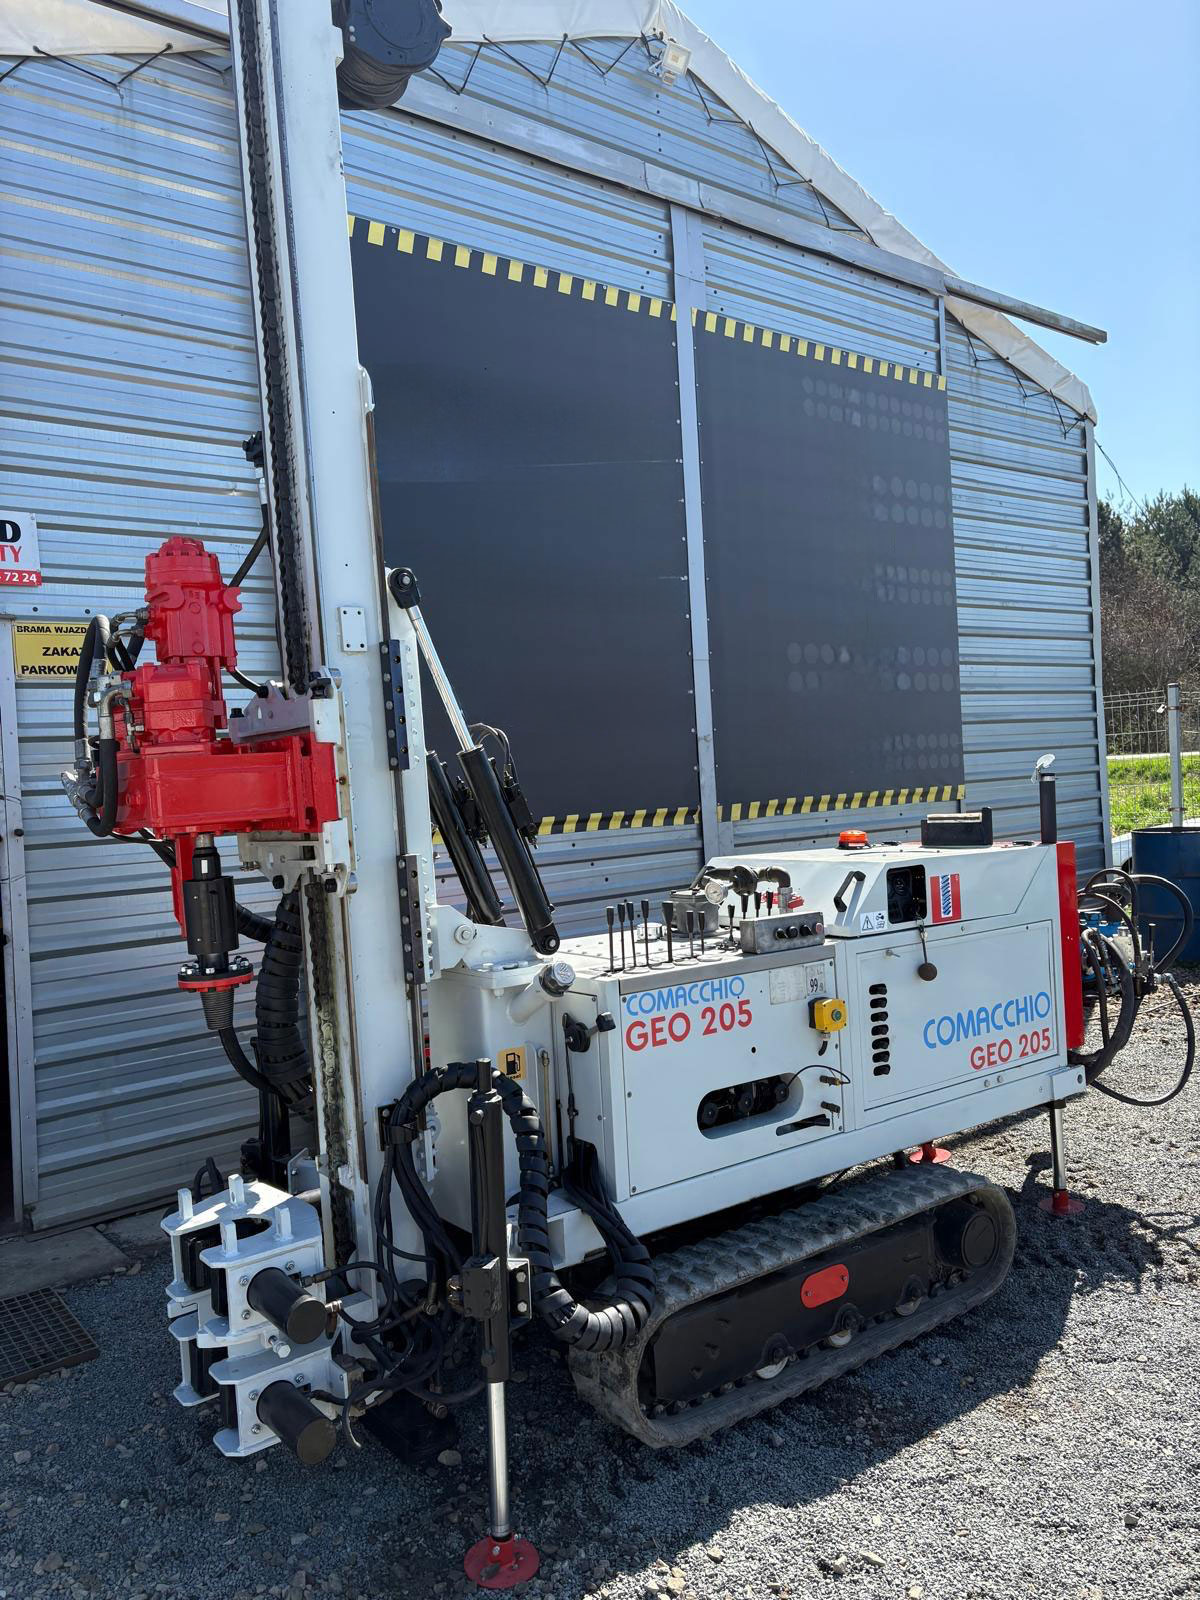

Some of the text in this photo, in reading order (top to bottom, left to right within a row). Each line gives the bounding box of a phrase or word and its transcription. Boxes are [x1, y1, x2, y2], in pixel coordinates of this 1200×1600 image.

[0, 520, 22, 543] D
[0, 544, 22, 563] TY
[4, 572, 37, 583] 72 24
[16, 625, 88, 634] BRAMA WJAZD
[21, 665, 78, 675] PARKOW
[809, 977, 818, 993] 99
[625, 976, 746, 1016] COMACCHIO
[625, 999, 753, 1053] GEO 205
[923, 991, 1052, 1050] COMACCHIO
[970, 1028, 1051, 1071] GEO 205
